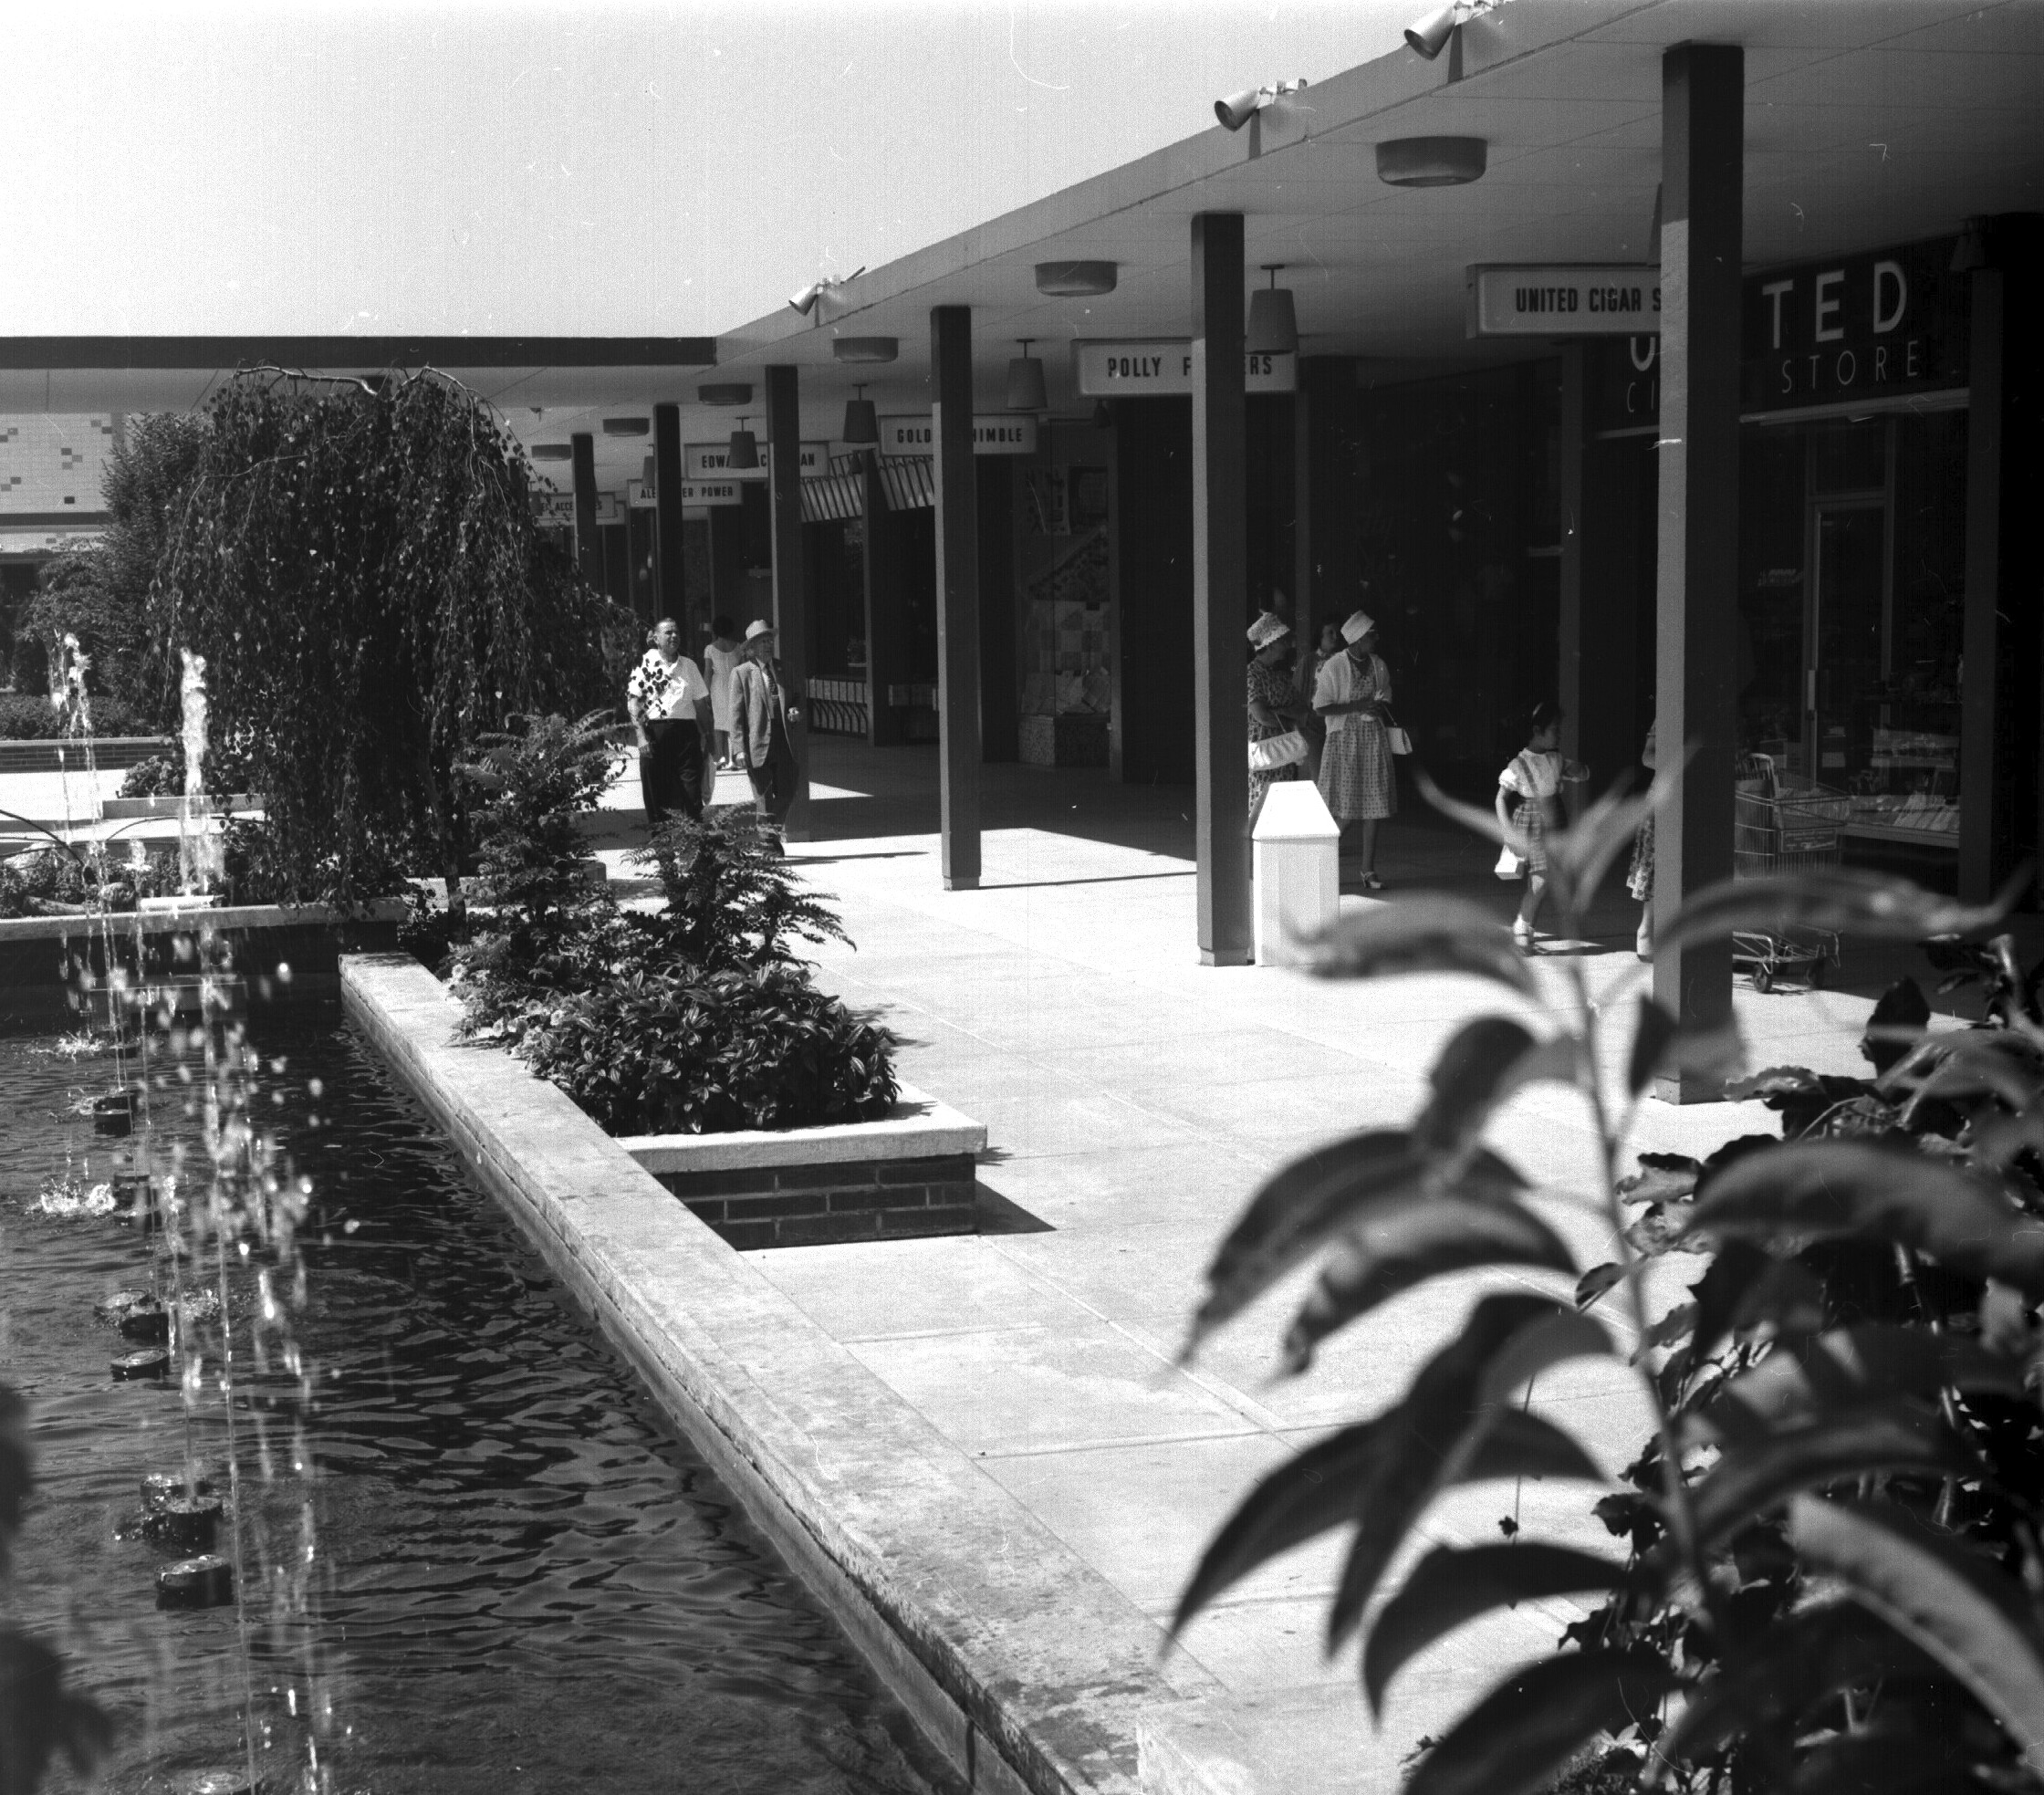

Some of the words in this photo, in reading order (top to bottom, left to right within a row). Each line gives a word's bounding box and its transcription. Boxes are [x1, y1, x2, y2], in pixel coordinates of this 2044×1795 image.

[1516, 287, 1579, 312] UNITED
[1589, 287, 1642, 312] CIGAR
[1108, 357, 1162, 377] POLLY
[1781, 339, 1919, 394] STORE
[973, 428, 1023, 443] HIMBLE
[641, 487, 694, 499] ALEER
[701, 486, 733, 497] POWER
